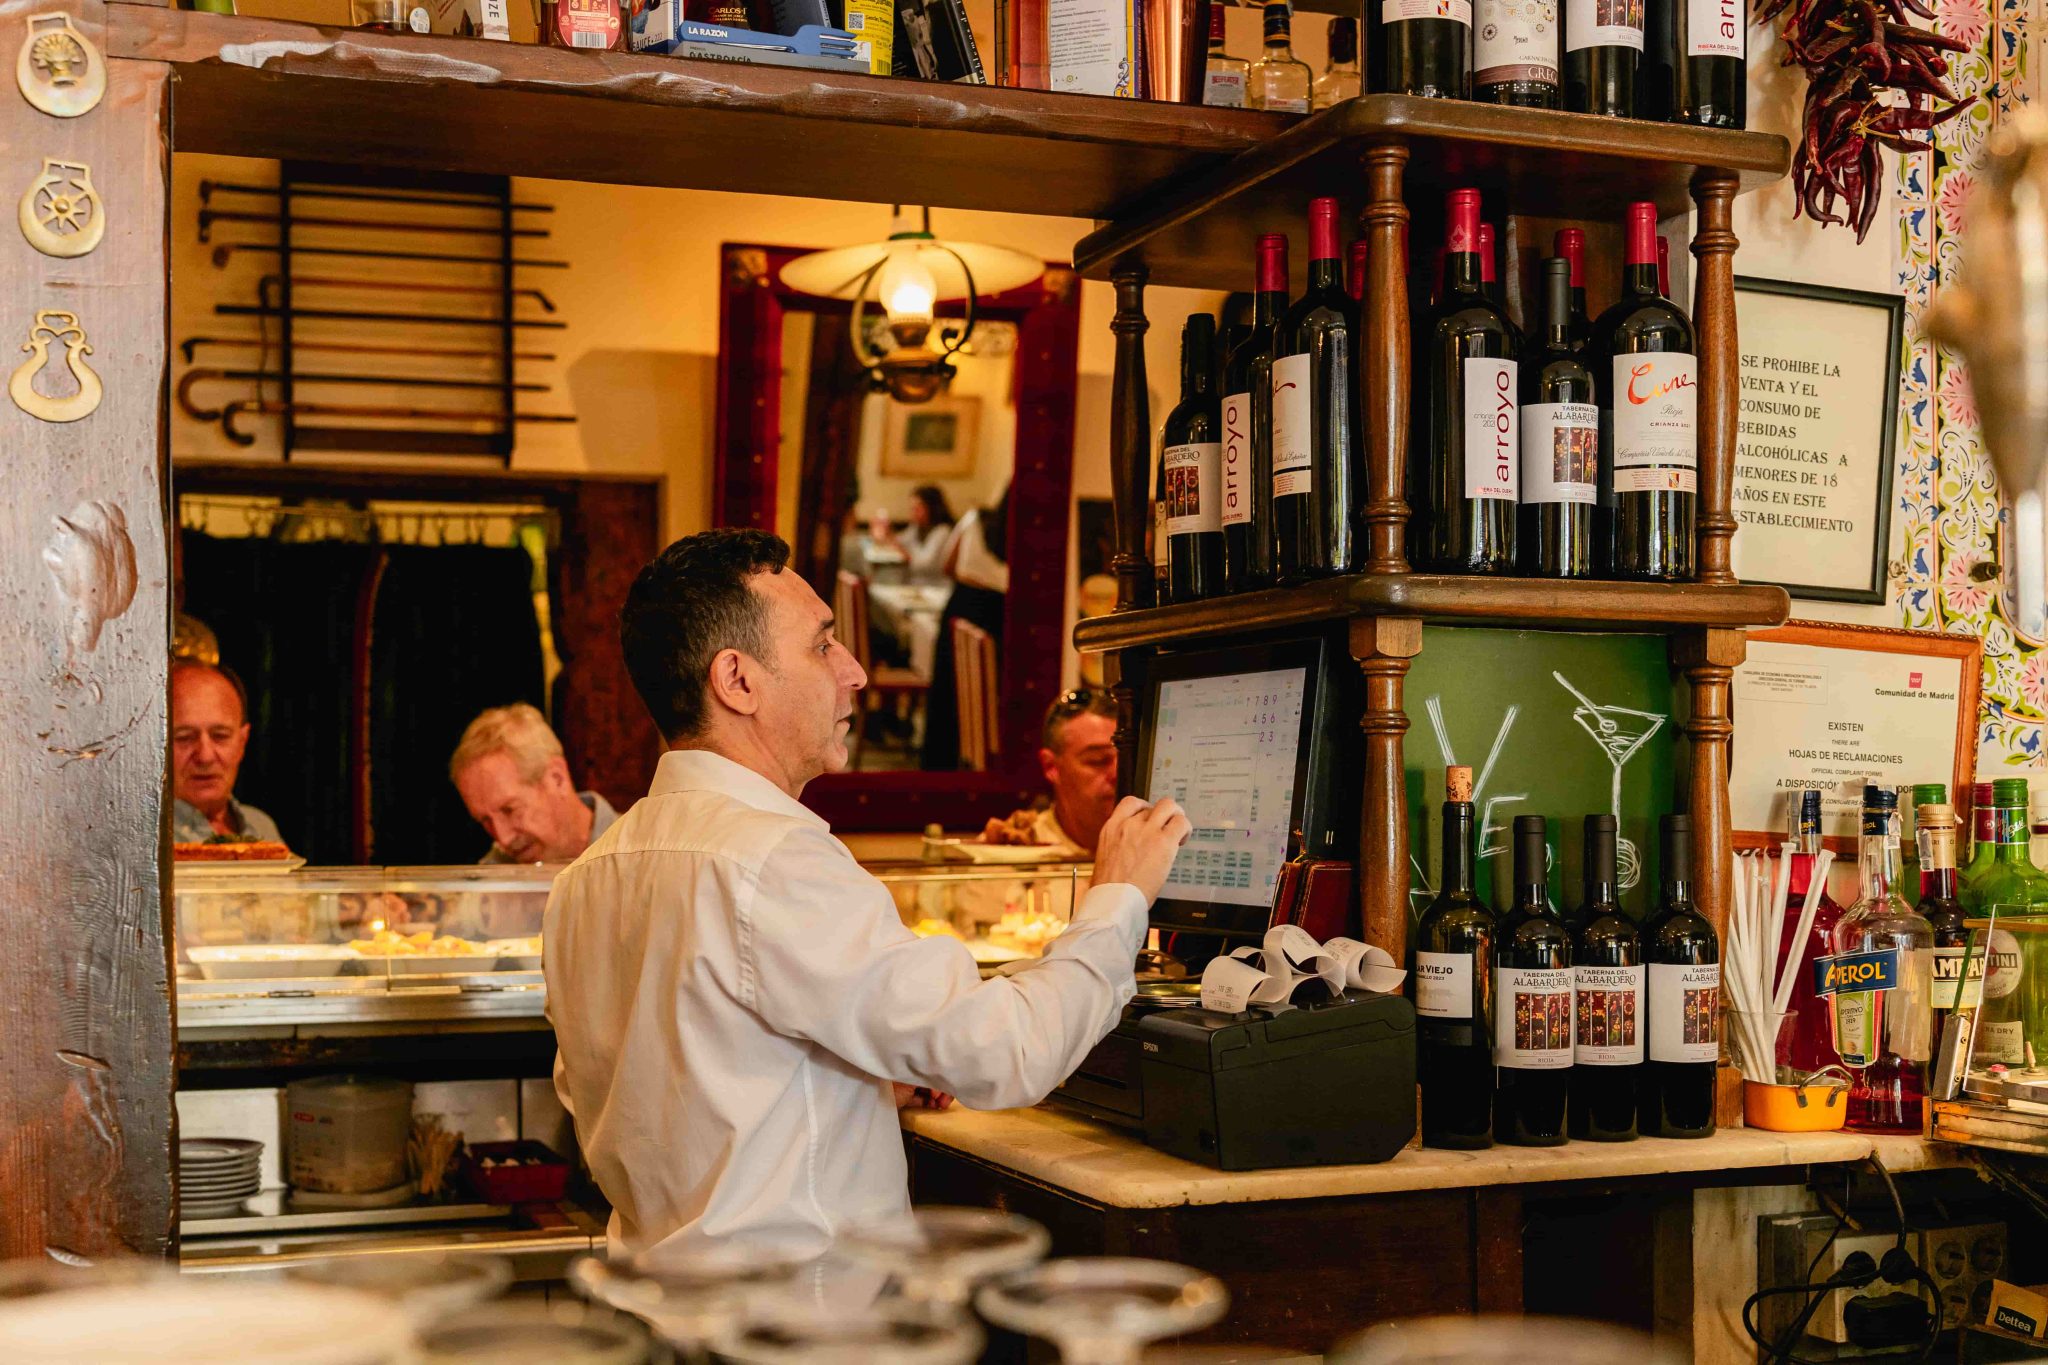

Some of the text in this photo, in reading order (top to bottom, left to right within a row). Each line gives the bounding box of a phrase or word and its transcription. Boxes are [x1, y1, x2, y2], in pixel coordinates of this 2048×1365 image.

[688, 26, 728, 38] LA RAZÓN
[1741, 354, 1841, 378] SE PROHIBE LA
[1627, 361, 1697, 406] Cune
[1740, 376, 1819, 398] VENTA Y EL
[1738, 398, 1821, 420] CONSUMO DE
[1496, 371, 1515, 482] arroyo
[1738, 421, 1797, 440] BEBIDAS
[1226, 406, 1245, 509] arroyo
[1736, 443, 1849, 468] ALCOHÓLICAS A
[1734, 465, 1839, 488] MENORES DE 18
[1733, 485, 1827, 509] AÑOS EN ESTE
[1731, 509, 1854, 533] ESTABLECIMIENTO
[1263, 695, 1269, 706] 8
[1272, 694, 1278, 705] 9
[1875, 688, 1955, 700] Comunidad de Madrid
[1828, 721, 1864, 732] EXISTEN
[1789, 749, 1903, 764] HOJAS DE RECLAMACIONES
[1811, 767, 1834, 775] OFFICIAL
[1835, 768, 1864, 777] COMPLAINT
[1776, 779, 1783, 787] A
[1987, 953, 2017, 968] TINI
[1426, 964, 1454, 975] VIEJO
[1825, 961, 1886, 988] APEROL
[1513, 976, 1572, 989] ALABARDERO
[1575, 974, 1636, 987] ALABARDERO
[1996, 1027, 2015, 1036] DRY
[1143, 1041, 1159, 1053] EPSON
[1998, 1311, 2032, 1333] Deltea
